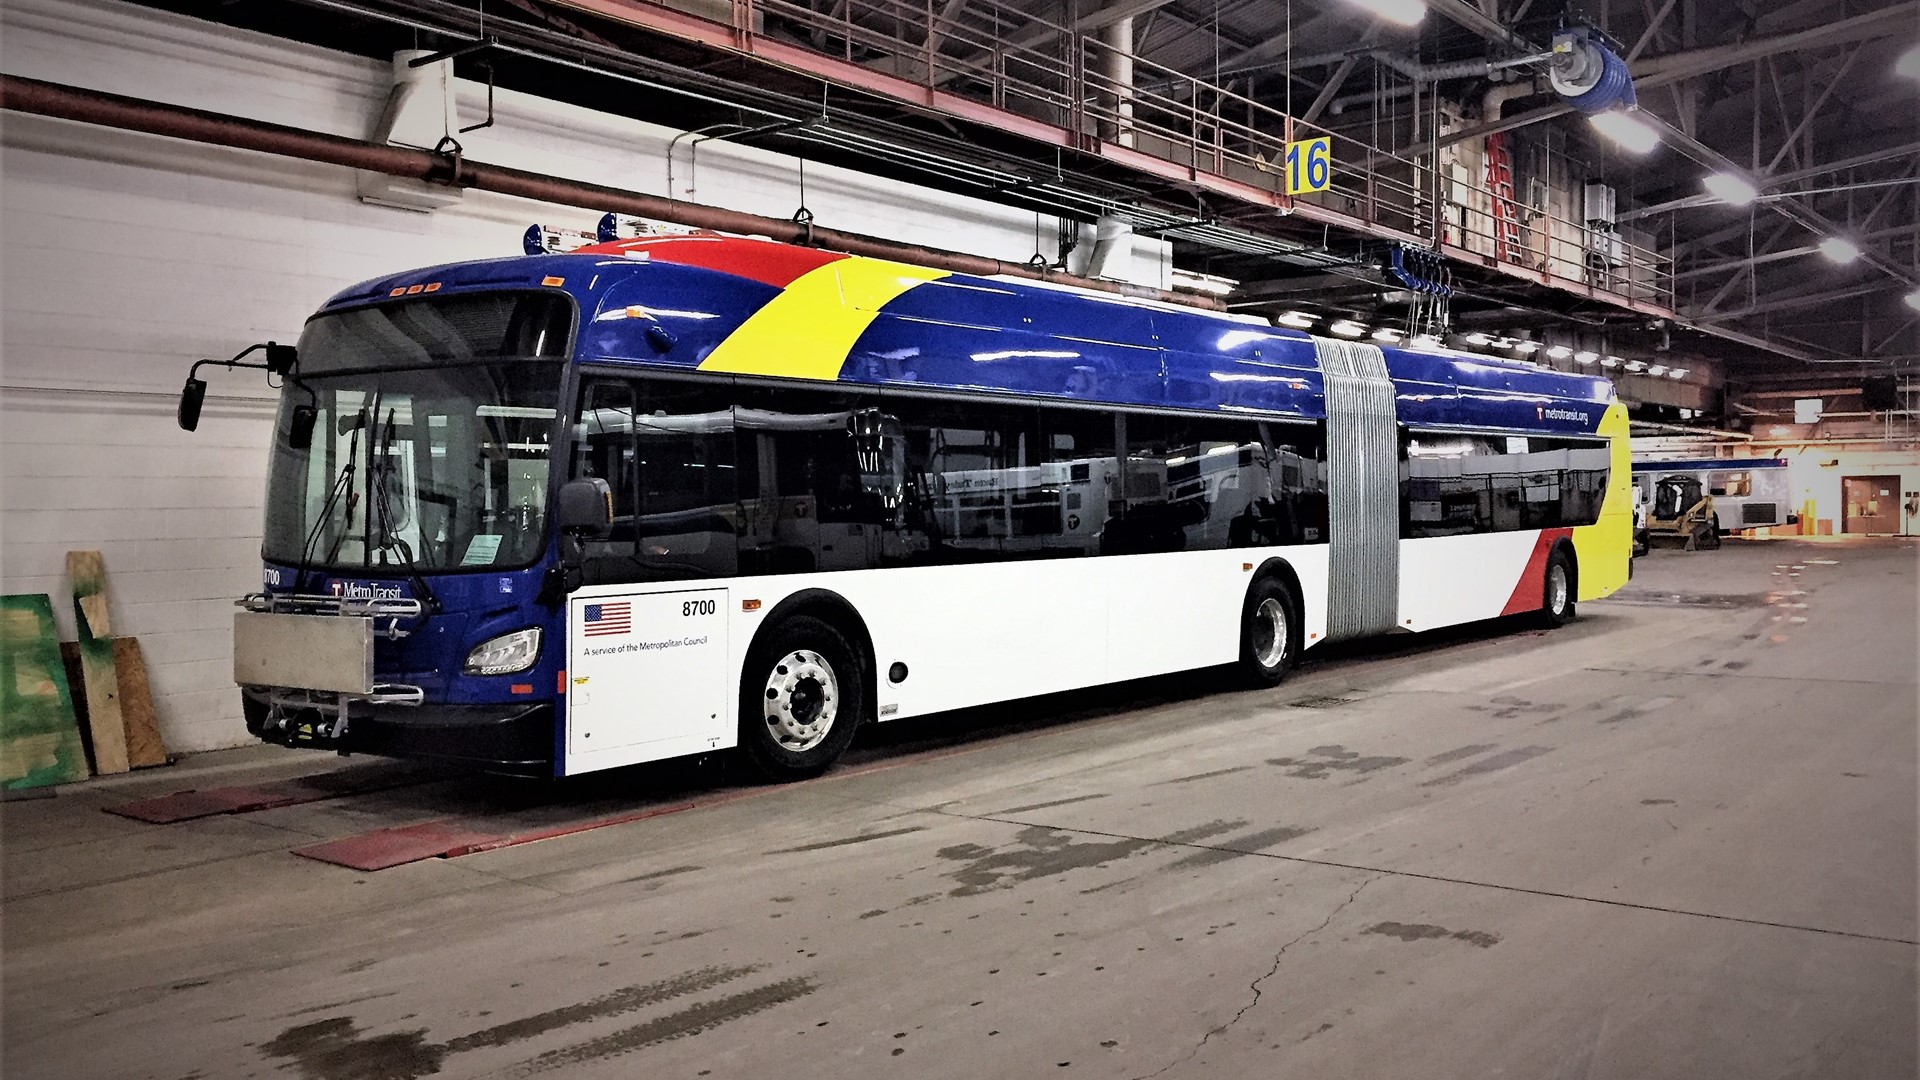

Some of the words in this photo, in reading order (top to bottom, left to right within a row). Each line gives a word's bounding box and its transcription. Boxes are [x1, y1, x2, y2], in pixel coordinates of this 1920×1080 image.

[1287, 141, 1328, 191] 16
[1545, 408, 1589, 425] metrotransit.org
[344, 582, 370, 598] Metro
[371, 583, 401, 599] Transit
[682, 599, 716, 616] 8700
[584, 648, 590, 656] A
[592, 647, 616, 656] service
[618, 643, 625, 653] of
[627, 643, 638, 652] the
[640, 639, 682, 651] Metropolitan
[684, 636, 708, 646] Council
